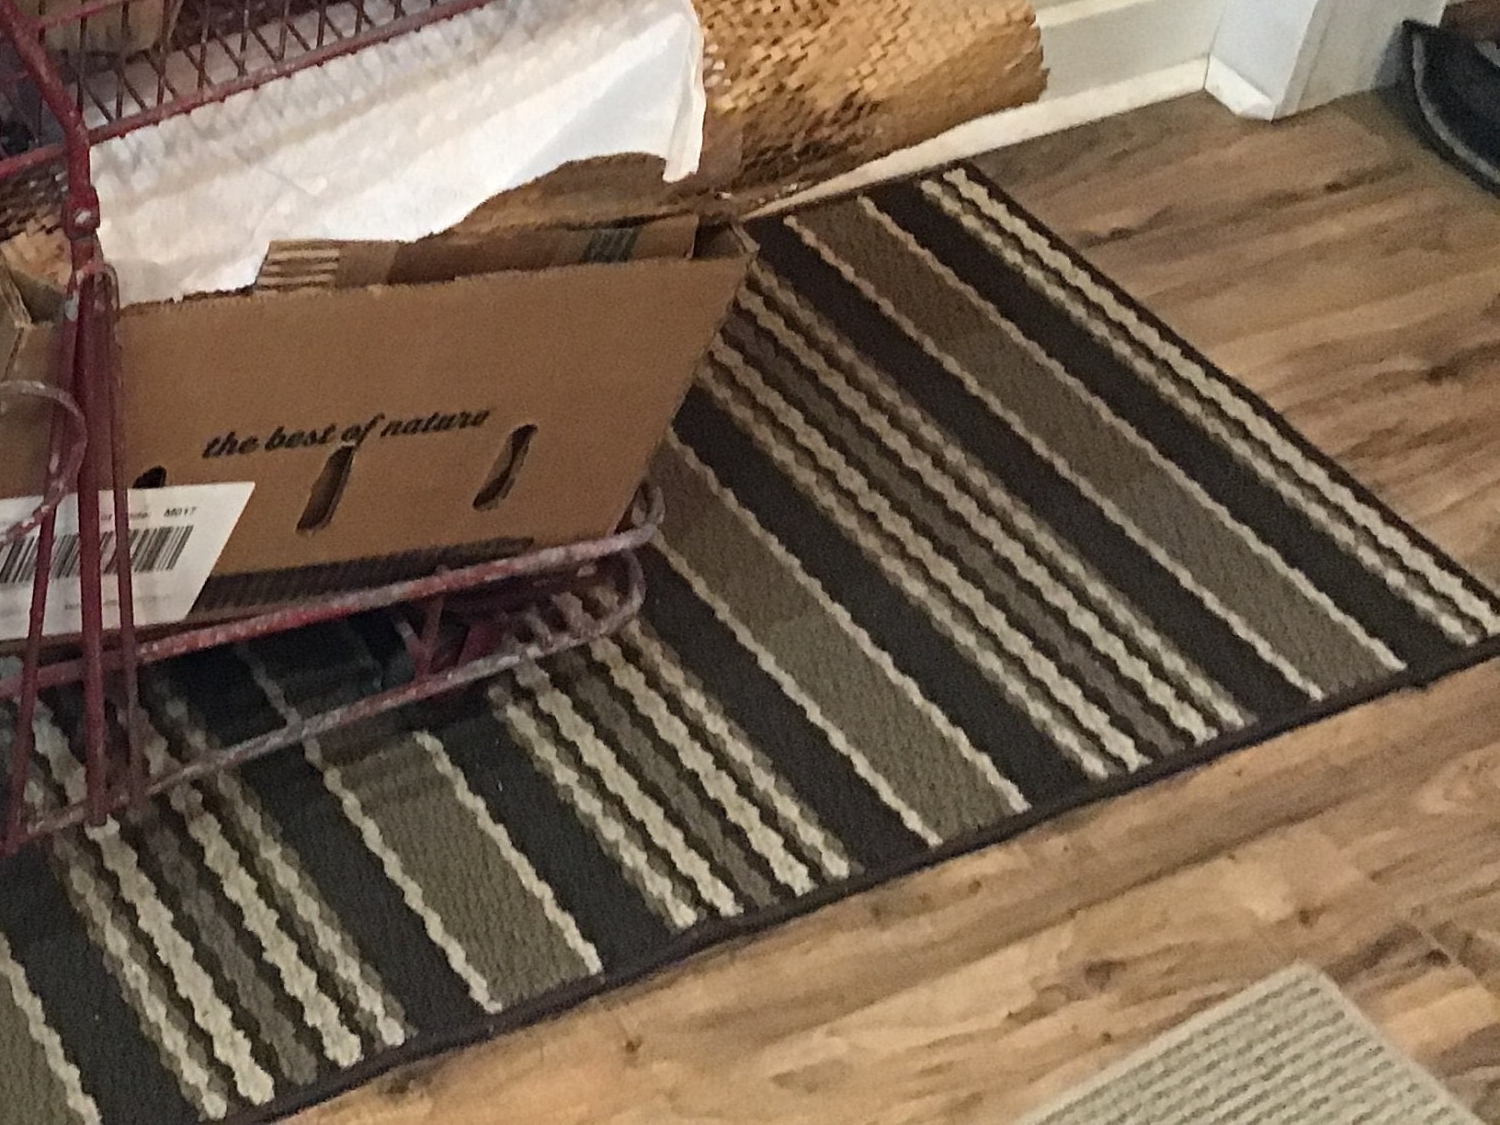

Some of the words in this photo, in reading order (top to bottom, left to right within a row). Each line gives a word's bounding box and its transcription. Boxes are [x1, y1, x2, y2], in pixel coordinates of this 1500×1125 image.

[202, 431, 260, 459] the
[264, 424, 338, 452] best
[340, 413, 386, 448] of
[380, 407, 494, 438] nature
[163, 506, 197, 518] M017
